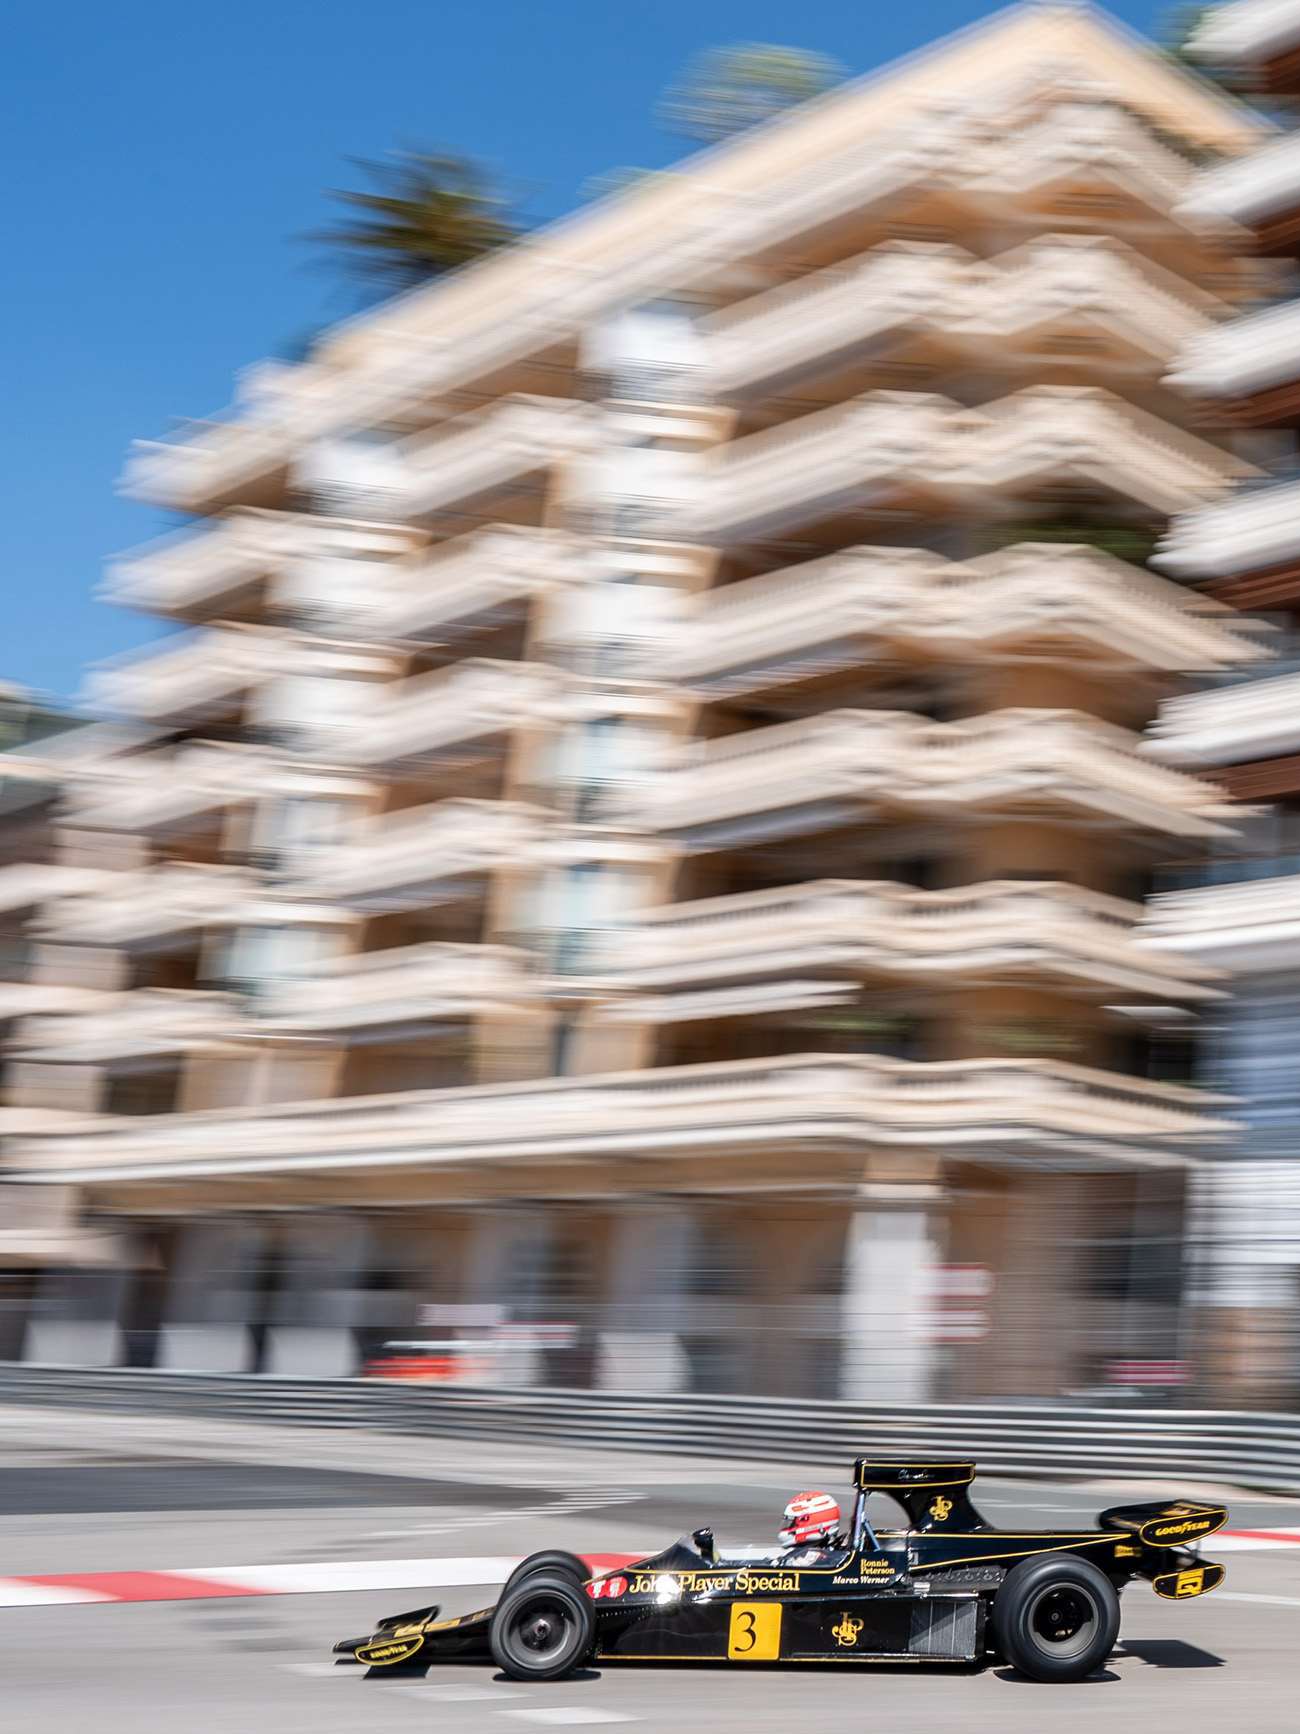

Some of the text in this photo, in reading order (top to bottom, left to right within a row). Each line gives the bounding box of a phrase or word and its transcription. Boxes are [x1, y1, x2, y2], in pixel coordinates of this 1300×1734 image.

[1154, 1520, 1211, 1537] GOODYEAR
[860, 1559, 889, 1568] Ronnie
[860, 1567, 895, 1575] Peterson
[677, 1573, 734, 1594] Player
[735, 1570, 800, 1594] Special
[832, 1575, 858, 1584] Marco
[860, 1575, 890, 1584] Werner
[733, 1611, 757, 1652] 3
